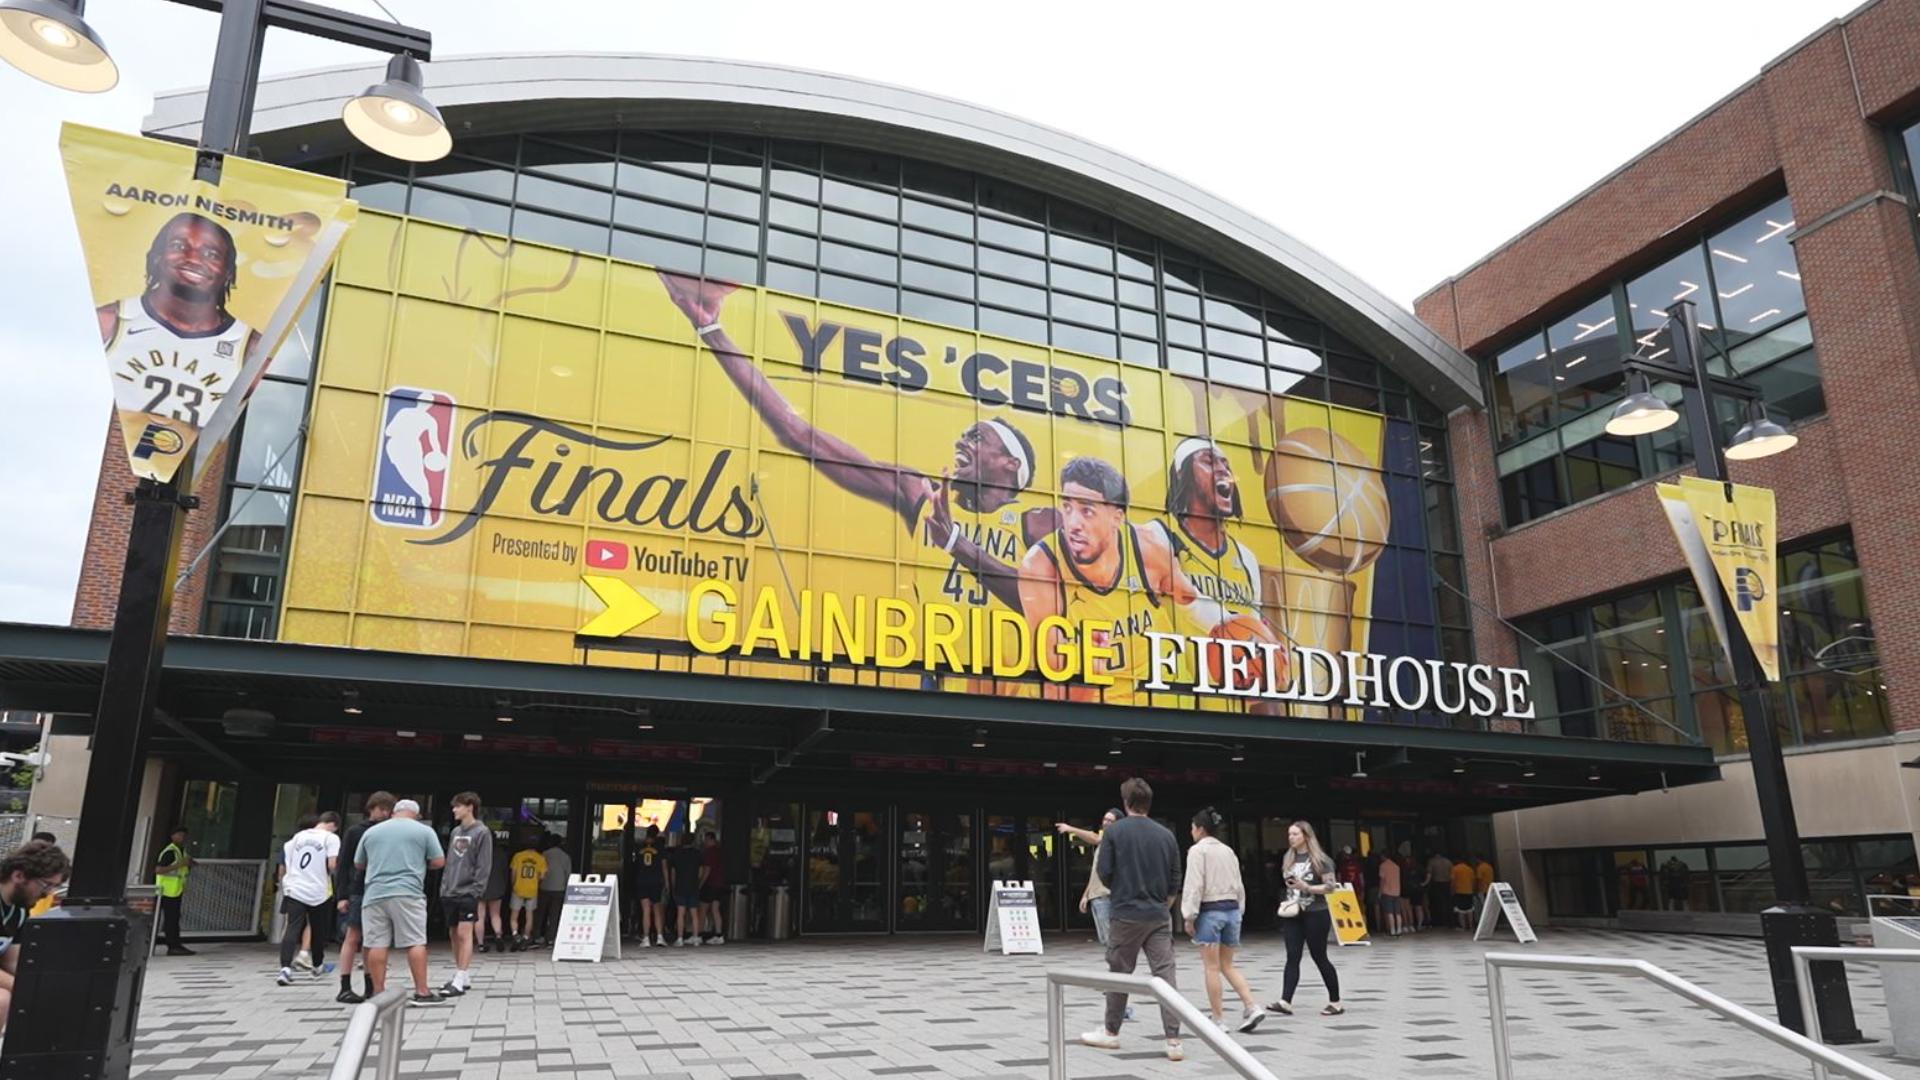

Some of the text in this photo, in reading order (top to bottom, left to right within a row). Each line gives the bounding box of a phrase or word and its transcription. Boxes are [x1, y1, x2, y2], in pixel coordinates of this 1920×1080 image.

[105, 183, 294, 231] AARON NESMITH
[115, 350, 224, 402] INDIANA
[780, 311, 929, 392] YES
[142, 375, 203, 427] 23
[404, 410, 765, 545] Finals
[381, 493, 417, 519] NBA
[492, 532, 749, 582] Presented by YouTube TV
[685, 579, 1535, 719] GAINBRIDGE FIELDHOUSE
[300, 852, 312, 869] 0
